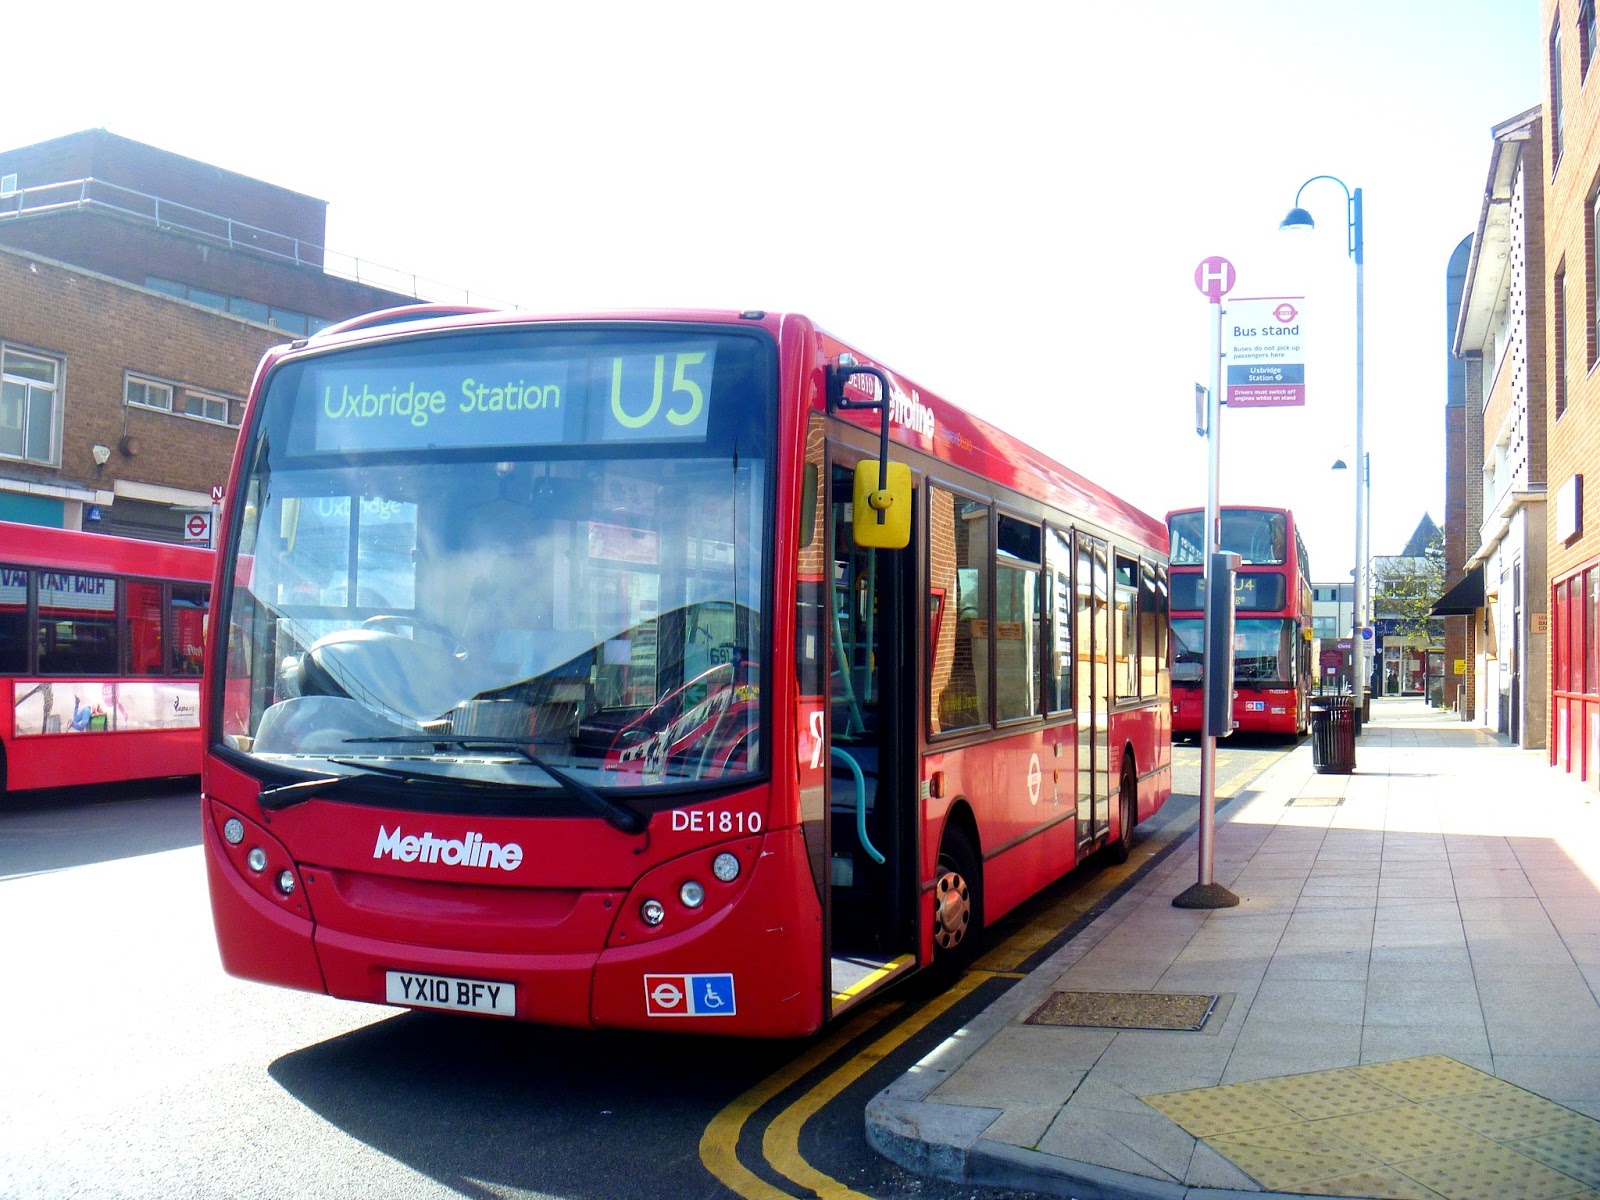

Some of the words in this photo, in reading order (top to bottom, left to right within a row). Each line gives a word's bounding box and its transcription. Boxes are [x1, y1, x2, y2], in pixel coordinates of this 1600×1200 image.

[1202, 262, 1228, 293] H
[1233, 326, 1257, 337] Bus
[1261, 325, 1299, 336] stand
[1250, 367, 1282, 375] Uxbridge
[323, 382, 447, 427] Uxbridge
[459, 377, 561, 413] Station
[610, 352, 708, 429] U5
[212, 486, 223, 498] N
[671, 810, 762, 833] DE1810
[373, 824, 524, 872] Metroline
[400, 976, 449, 1004] YX10
[456, 982, 501, 1009] BFY
